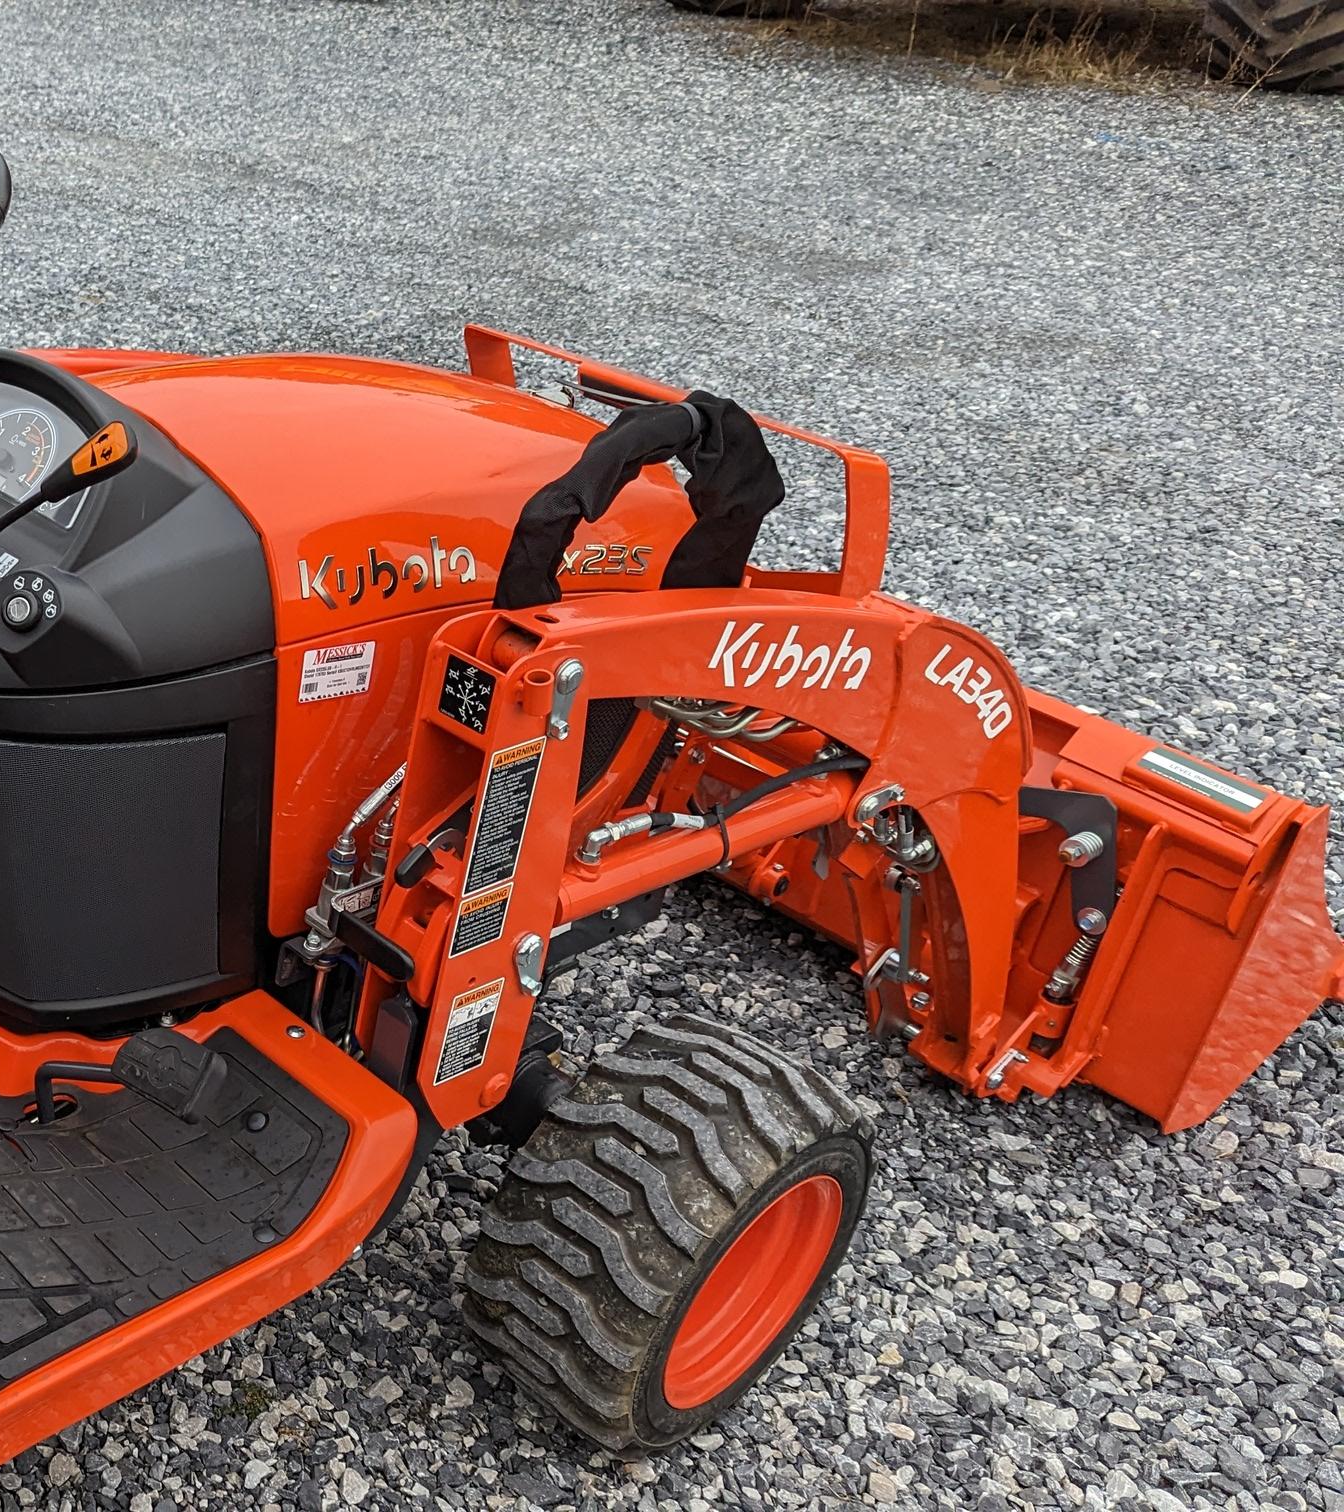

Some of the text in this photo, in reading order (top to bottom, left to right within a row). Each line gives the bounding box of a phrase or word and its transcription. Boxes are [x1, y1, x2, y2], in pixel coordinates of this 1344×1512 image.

[22, 426, 31, 436] 2
[32, 446, 41, 456] 3
[18, 473, 27, 482] 4
[298, 535, 477, 610] Kubota
[313, 644, 366, 665] MESSICK'S
[708, 620, 1014, 740] Kubota LA340
[503, 741, 541, 762] WARNING
[470, 888, 507, 909] WARNING
[463, 983, 499, 1004] WARNING
